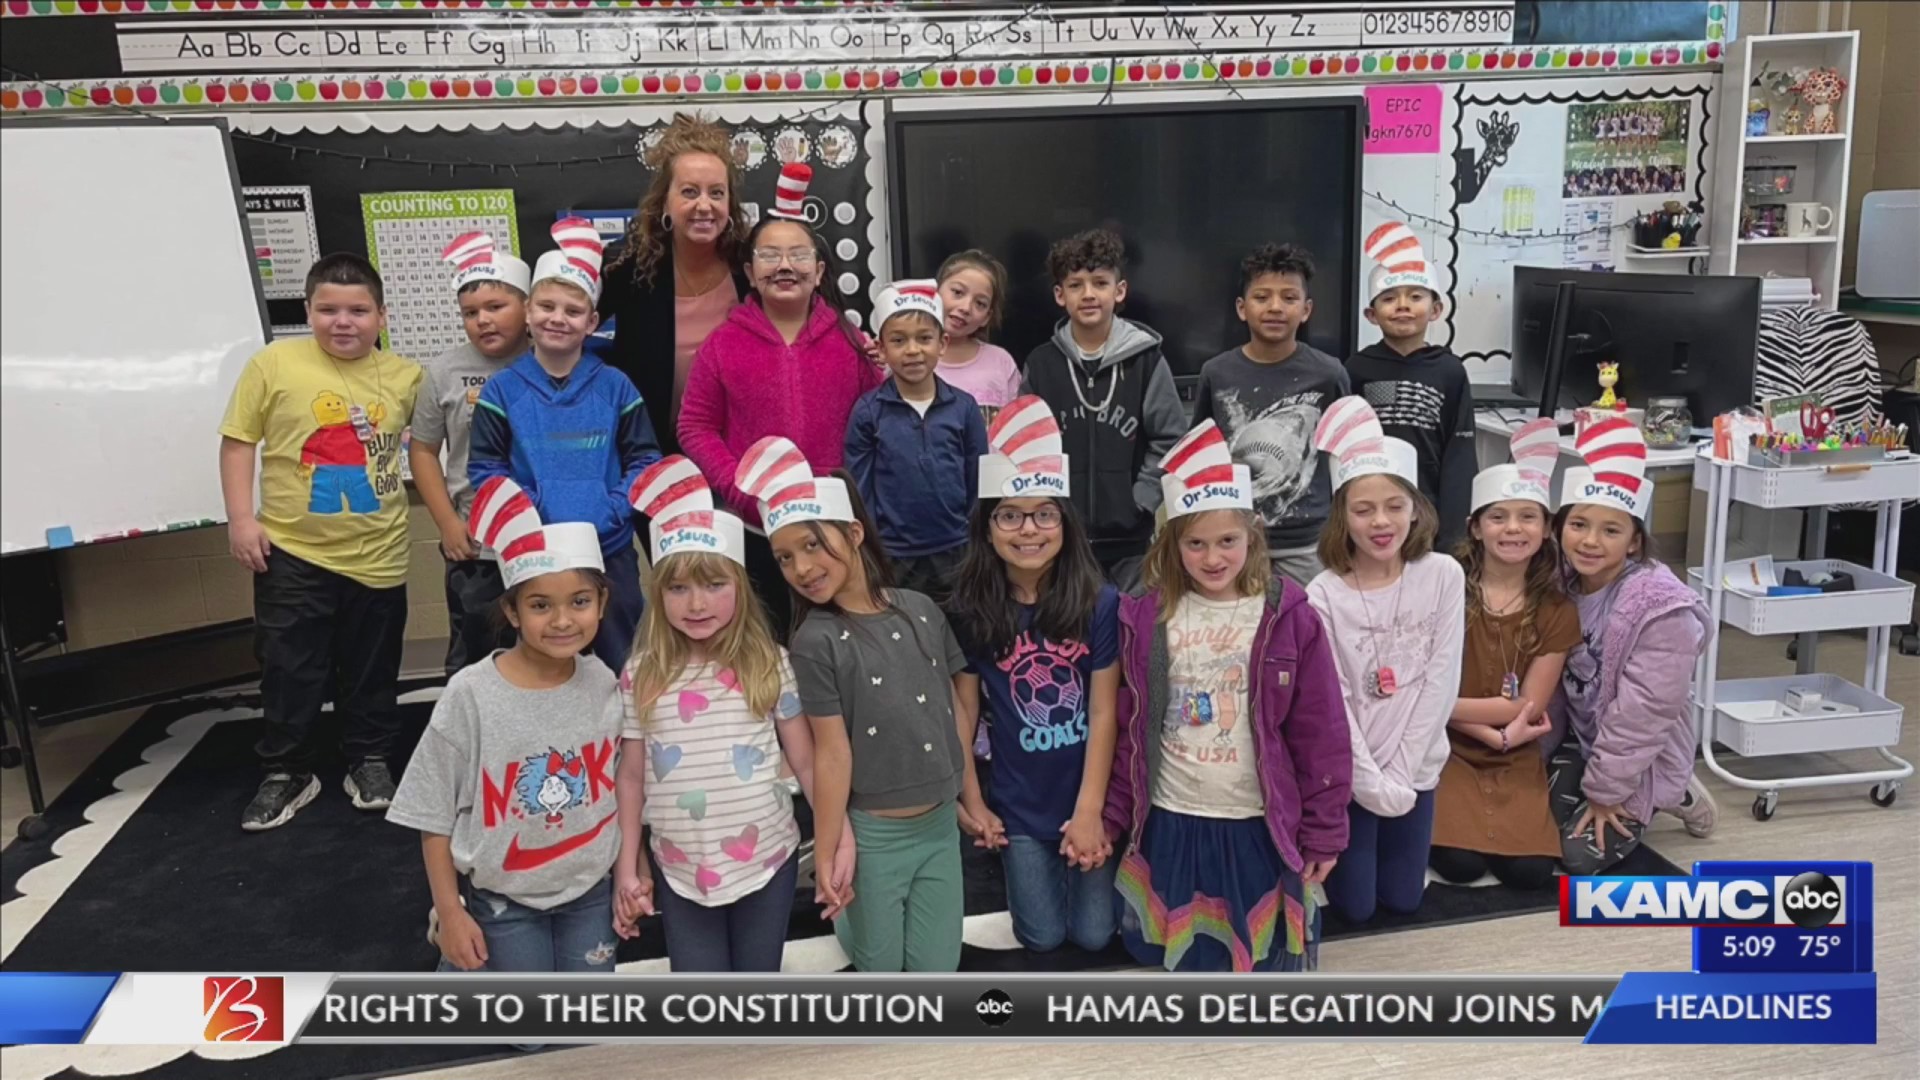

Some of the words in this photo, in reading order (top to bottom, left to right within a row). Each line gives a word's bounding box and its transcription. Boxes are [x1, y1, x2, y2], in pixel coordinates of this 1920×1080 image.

[178, 33, 214, 57] Aa
[225, 32, 262, 57] Bb
[275, 32, 310, 56] Cc
[324, 30, 360, 56] Dd
[375, 30, 407, 55] Ee
[424, 30, 453, 55] Ff
[468, 31, 505, 64] Gg
[522, 30, 555, 53] Hh
[576, 29, 590, 52] Ii
[615, 29, 641, 62] Jj
[659, 29, 687, 51] Kk
[708, 26, 728, 50] Ll
[741, 27, 781, 50] Mm
[789, 27, 819, 49] Nn
[830, 24, 863, 47] Oo
[884, 23, 911, 54] Pp
[923, 23, 955, 54] Qq
[1007, 20, 1031, 44] Ss
[1050, 20, 1074, 42] Tt
[1090, 18, 1118, 41] Uu
[1131, 18, 1155, 39] Vv
[1164, 17, 1198, 38] Ww
[1211, 16, 1239, 37] Xx
[1250, 15, 1276, 47] Yy
[1290, 15, 1316, 37] Zz
[1363, 11, 1511, 35] 012345678910
[1386, 98, 1421, 113] EPIC
[1371, 123, 1432, 143] gkn7670
[272, 198, 301, 208] WEEK
[370, 198, 454, 214] COUNTING
[459, 197, 479, 210] TO
[483, 196, 508, 210] 120
[560, 264, 575, 273] Dr
[1384, 276, 1398, 285] Dr
[894, 296, 909, 307] Dr
[1011, 477, 1031, 492] Dr
[1033, 472, 1064, 491] Seuss
[1182, 491, 1201, 508] Dr
[1203, 484, 1239, 499] Seuss
[1584, 484, 1604, 496] Dr
[1606, 485, 1636, 510] Seuss
[766, 509, 781, 528] Dr
[782, 502, 822, 516] Seuss
[660, 535, 674, 552] Dr
[675, 528, 717, 547] Seuss
[1019, 711, 1088, 752] GOALS
[1196, 747, 1238, 763] USA
